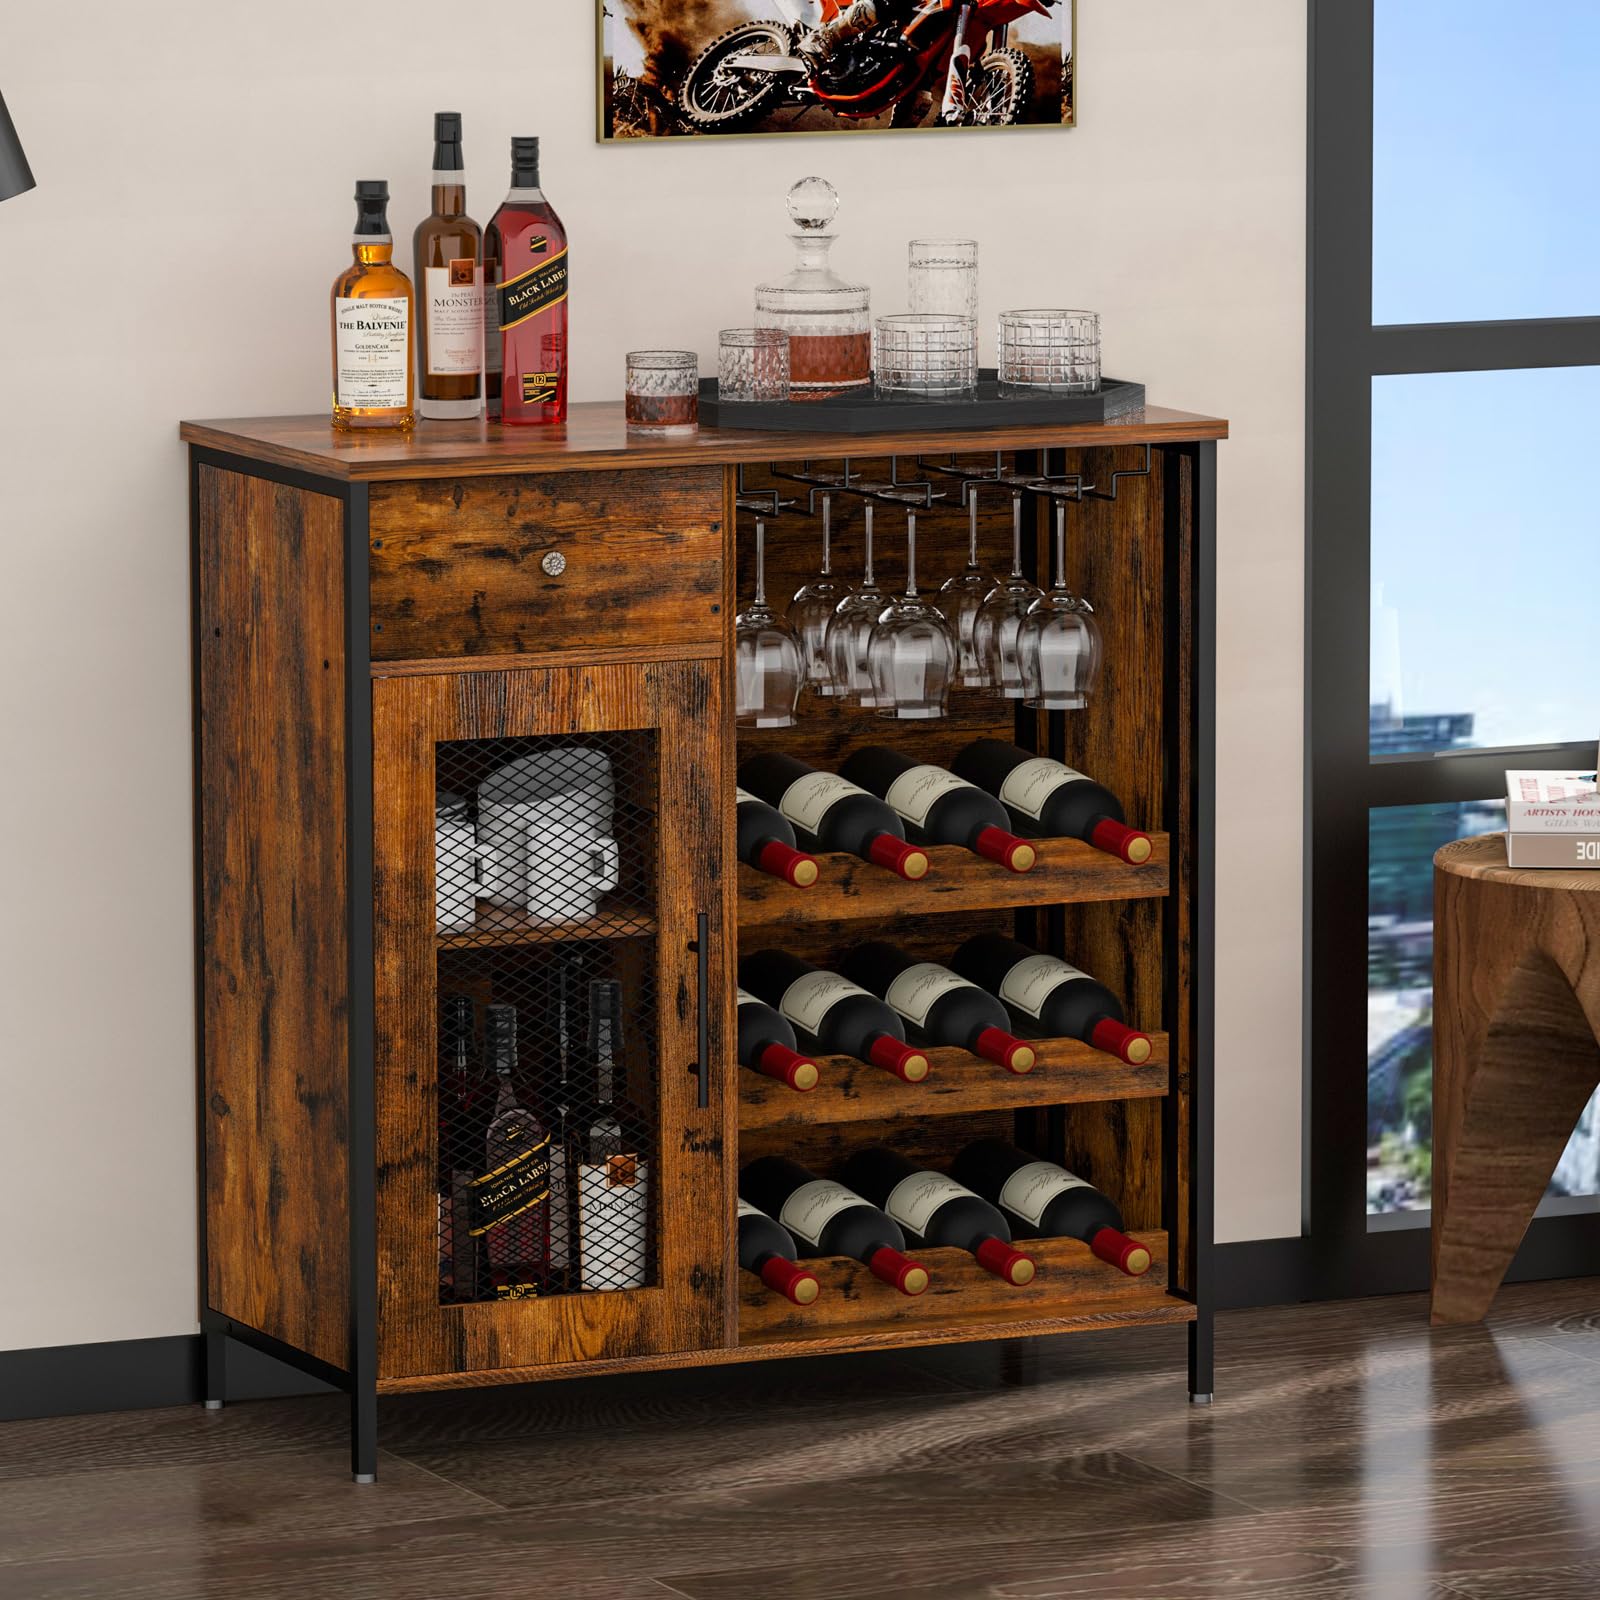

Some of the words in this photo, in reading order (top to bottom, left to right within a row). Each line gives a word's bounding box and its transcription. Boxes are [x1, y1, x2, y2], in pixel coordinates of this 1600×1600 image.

[508, 283, 541, 306] BLACK
[540, 268, 568, 288] LABEL
[340, 321, 355, 330] THE
[356, 320, 405, 330] BALVENIE
[536, 376, 544, 384] 12
